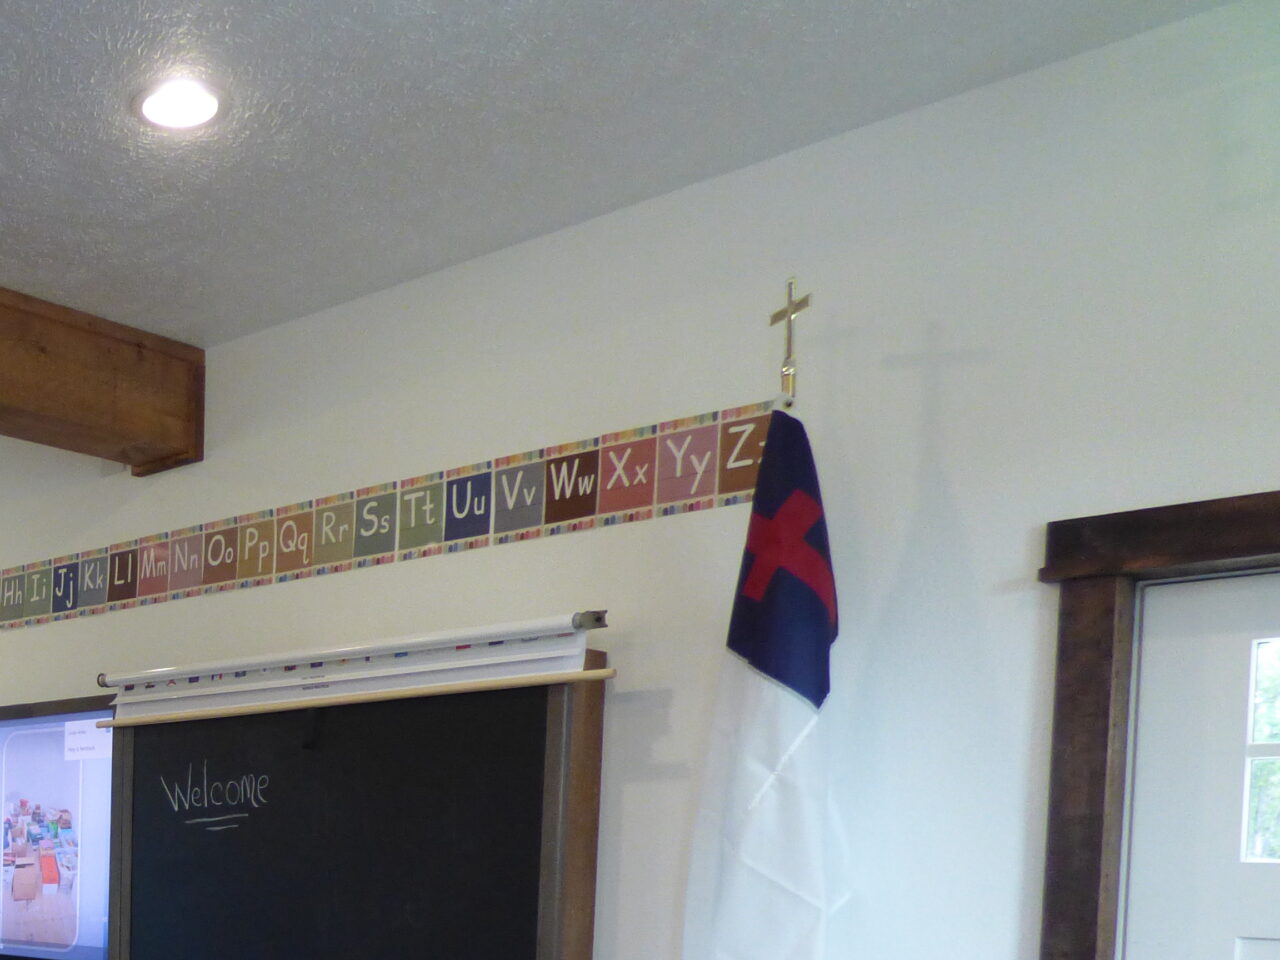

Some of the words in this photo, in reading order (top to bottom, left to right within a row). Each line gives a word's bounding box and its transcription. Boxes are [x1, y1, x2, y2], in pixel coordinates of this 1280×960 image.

[3, 581, 22, 606] Hh
[31, 574, 47, 601] Ii
[55, 568, 73, 609] Jj
[83, 557, 103, 592] Kk
[114, 553, 132, 585] Ll
[141, 547, 167, 579] Mm
[174, 541, 198, 572] Nn
[207, 534, 234, 566] Oo
[244, 527, 269, 573] Pp
[279, 520, 309, 565] Qq
[321, 511, 349, 545] Rr
[360, 501, 390, 536] Ss
[404, 490, 435, 527] Tt
[452, 480, 485, 519] Uu
[501, 470, 536, 510] Vv
[550, 458, 595, 499] Ww
[606, 448, 648, 490] Xx
[666, 435, 711, 495] Yy
[726, 423, 766, 470] Z
[160, 759, 269, 812] Welcome
